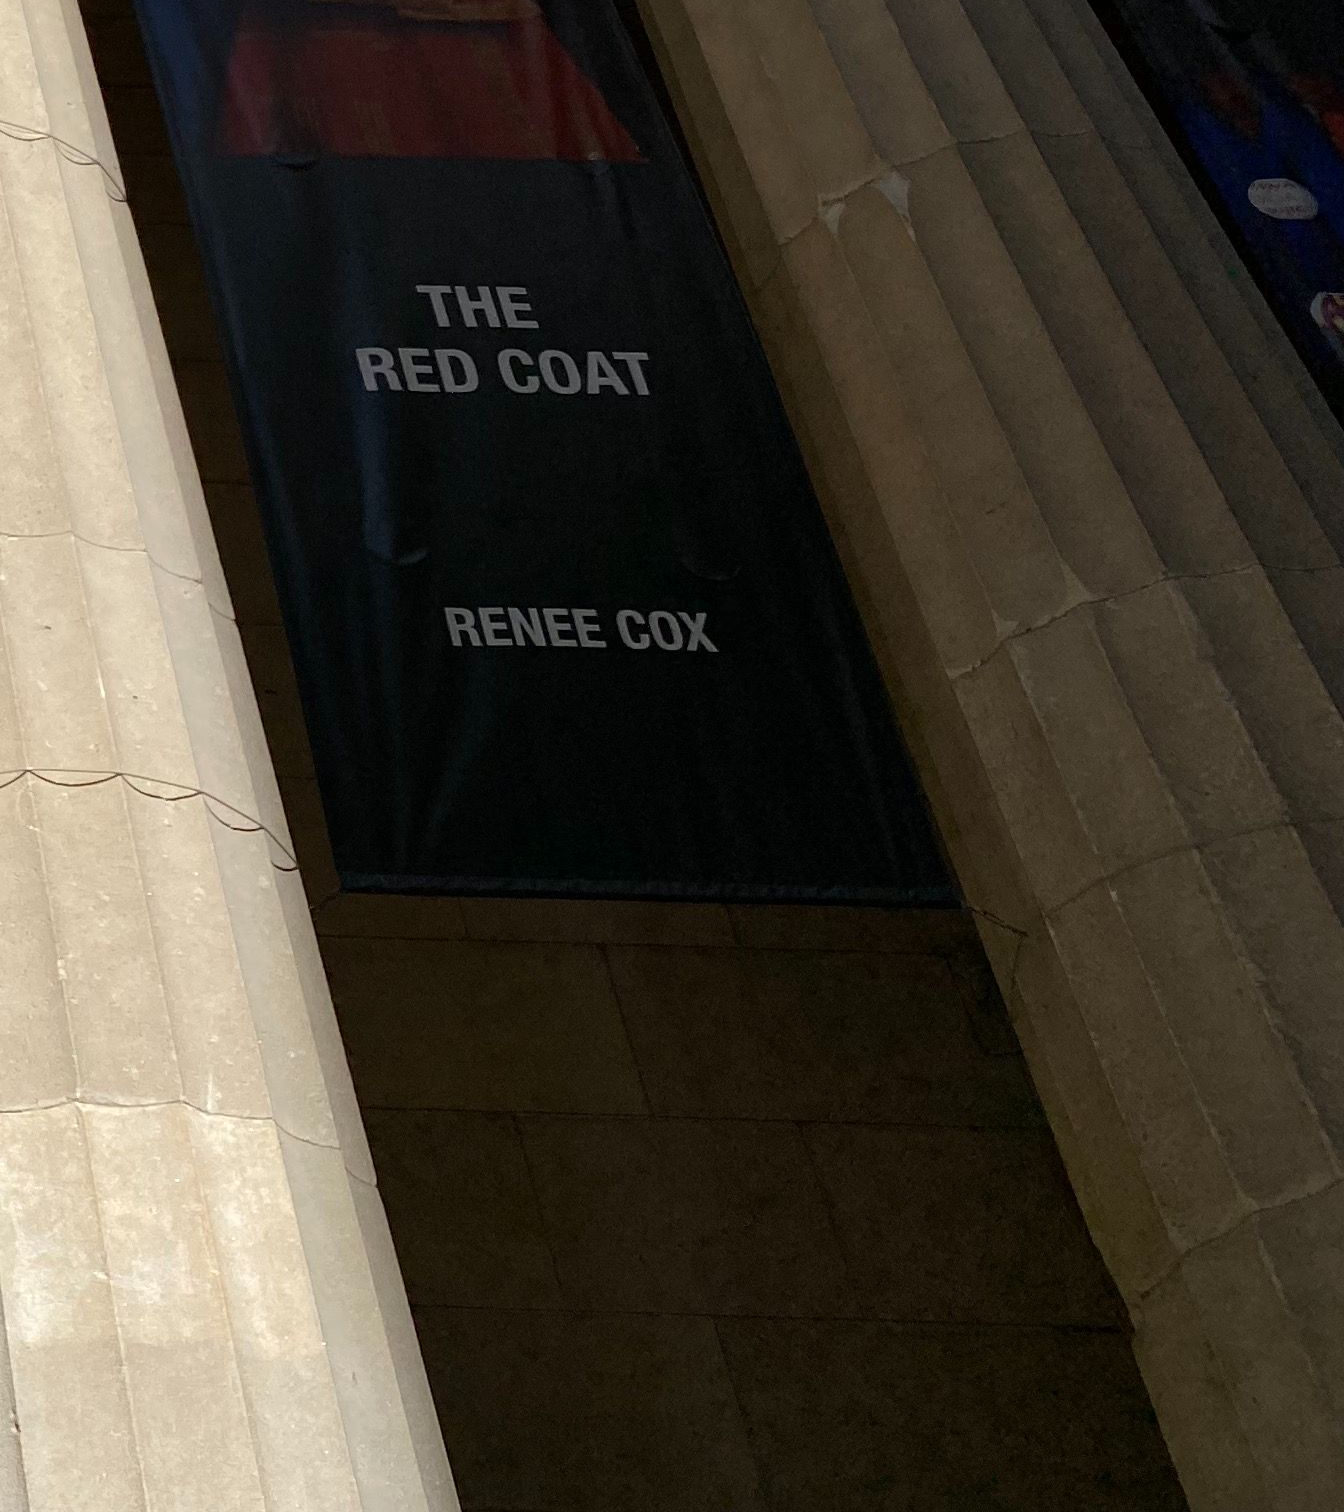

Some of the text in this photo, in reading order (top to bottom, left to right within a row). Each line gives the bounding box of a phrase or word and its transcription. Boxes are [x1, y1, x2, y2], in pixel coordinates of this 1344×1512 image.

[415, 284, 540, 329] THE
[355, 347, 651, 396] RED COAT
[444, 606, 719, 653] RENEE COX
